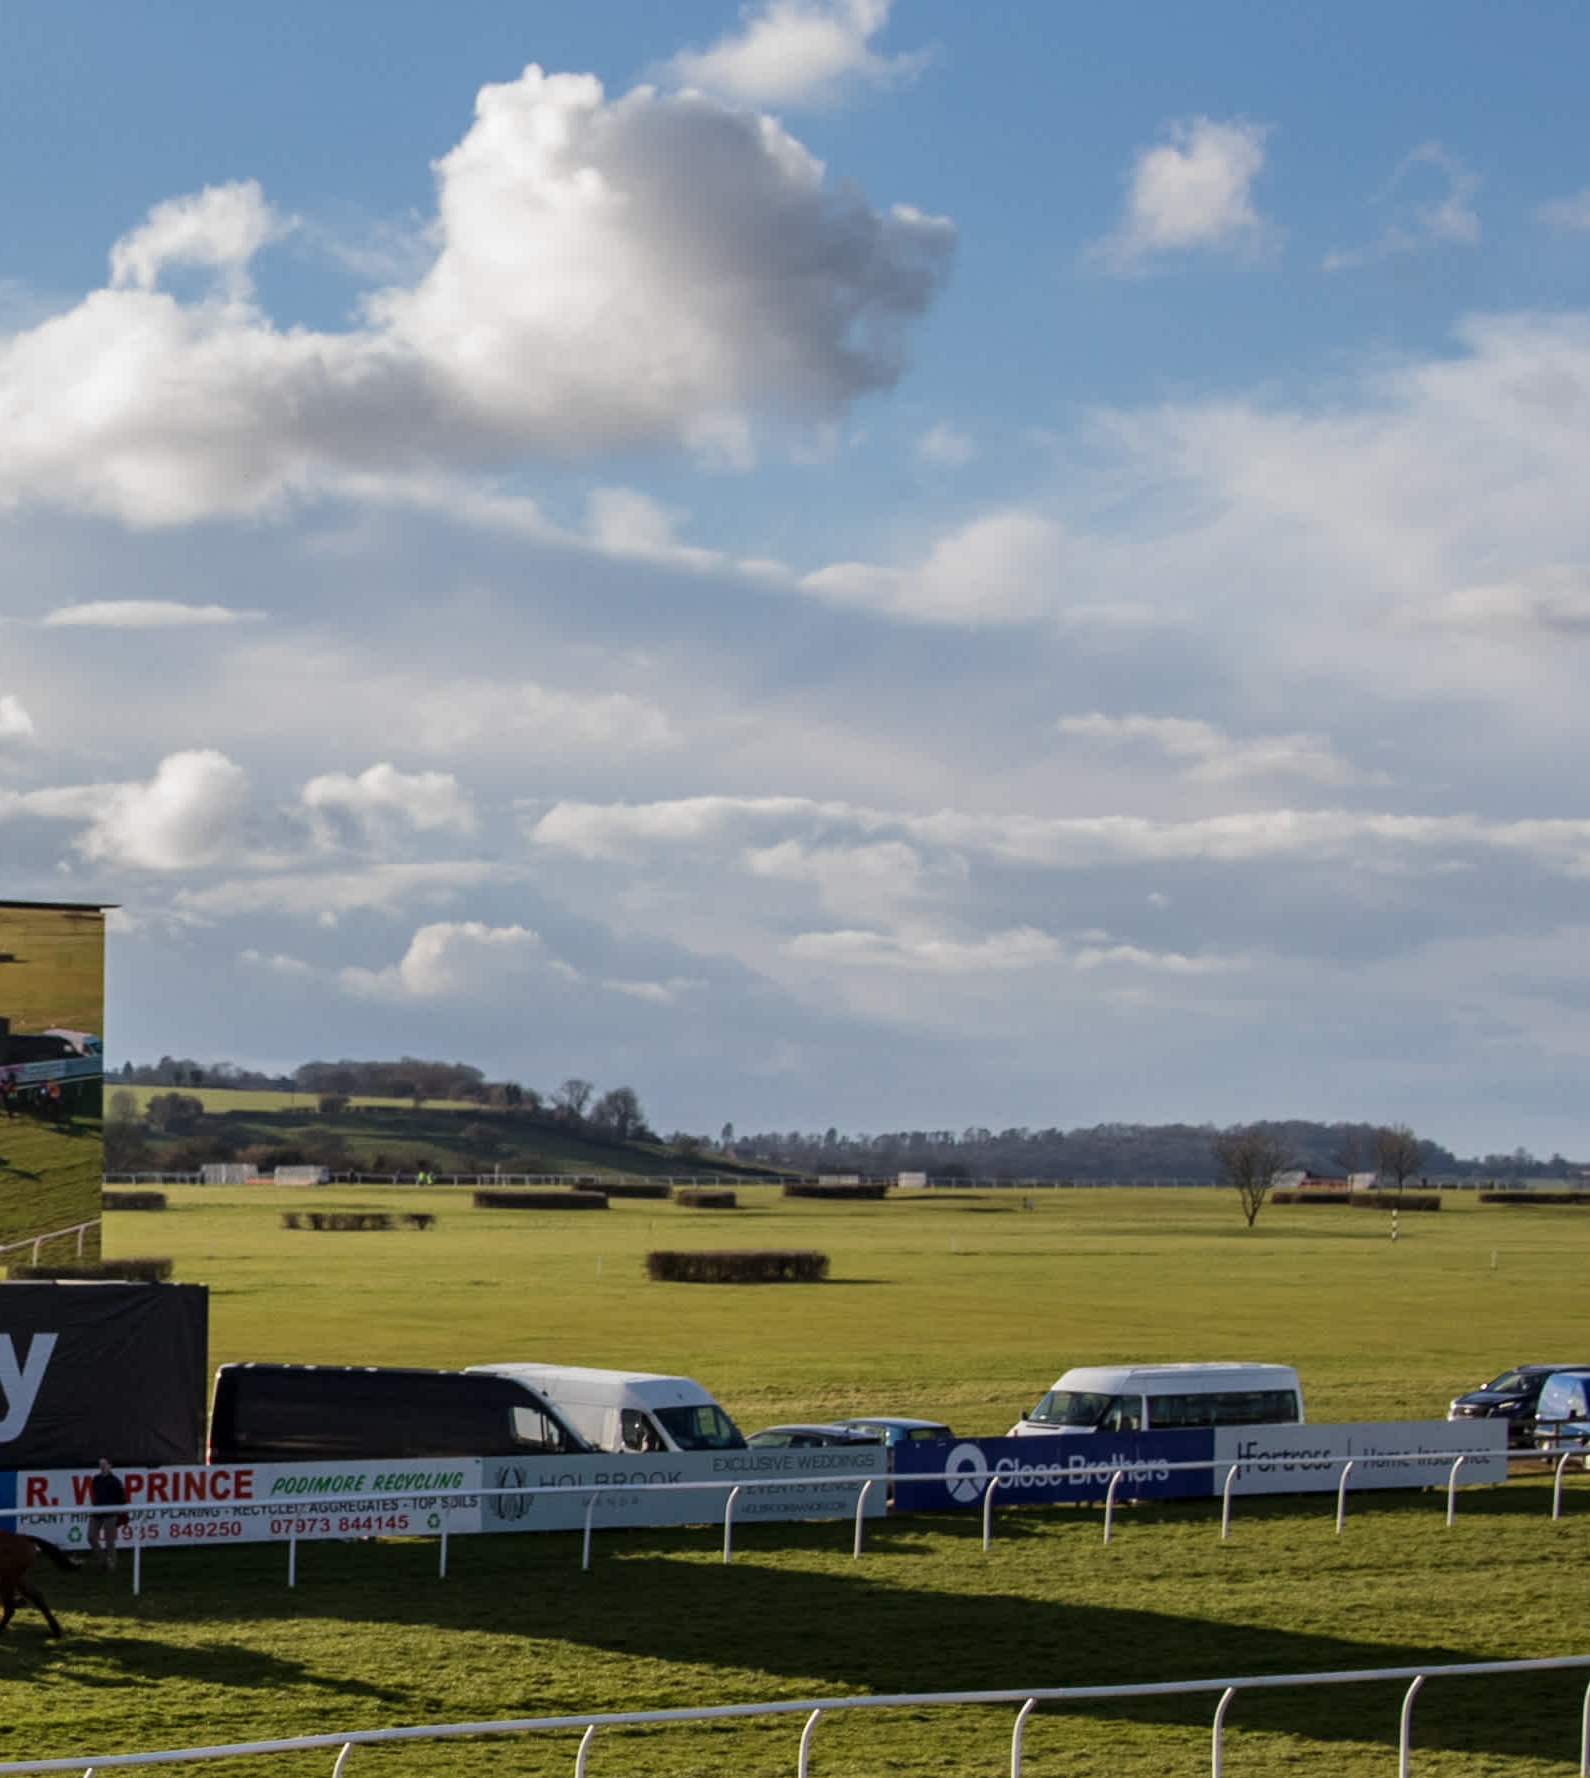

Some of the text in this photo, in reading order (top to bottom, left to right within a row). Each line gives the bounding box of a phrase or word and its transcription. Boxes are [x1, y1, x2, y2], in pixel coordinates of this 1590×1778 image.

[713, 1453, 875, 1472] EXCLUSIVE WEDDINGS
[995, 1452, 1169, 1489] Close Brothers
[124, 1469, 254, 1504] PRINCE
[271, 1471, 464, 1495] PODIMORE RECYCLING
[309, 1499, 399, 1514] AGGREGATES
[413, 1497, 437, 1510] TOP
[169, 1521, 242, 1539] 849250
[270, 1518, 330, 1534] 07973
[338, 1515, 409, 1532] 844145
